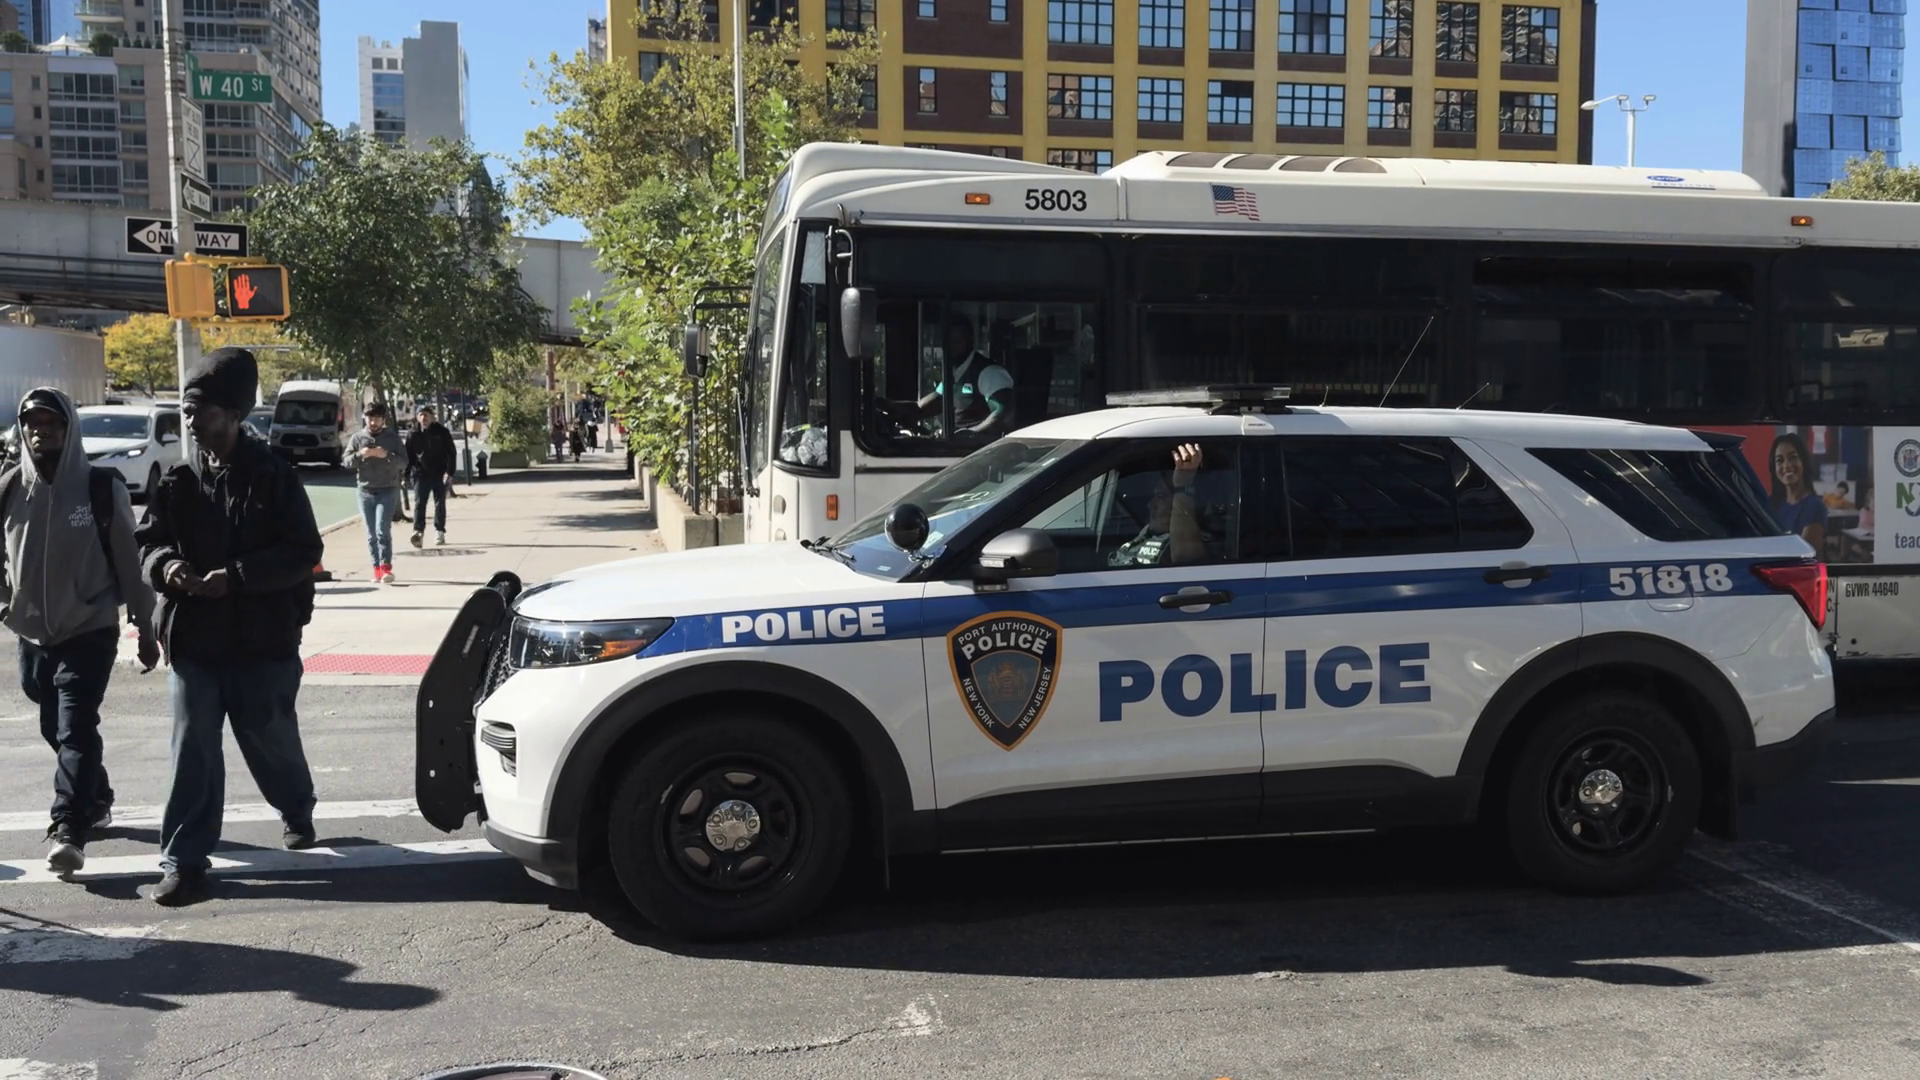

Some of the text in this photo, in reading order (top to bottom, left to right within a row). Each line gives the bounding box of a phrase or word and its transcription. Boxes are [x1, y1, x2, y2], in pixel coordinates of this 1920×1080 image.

[199, 75, 263, 98] W 40 St
[1025, 188, 1087, 212] 5803
[146, 230, 232, 248] ON WAY
[1609, 563, 1733, 596] 51818
[1845, 581, 1899, 598] GVWR 44640
[722, 605, 886, 643] POLICE
[958, 622, 1052, 645] PORT AUTHORITY
[961, 632, 1047, 660] POLICE
[1099, 642, 1431, 722] POLICE
[963, 678, 995, 728] NEW YORK
[1018, 666, 1052, 729] NEW JERSEY
